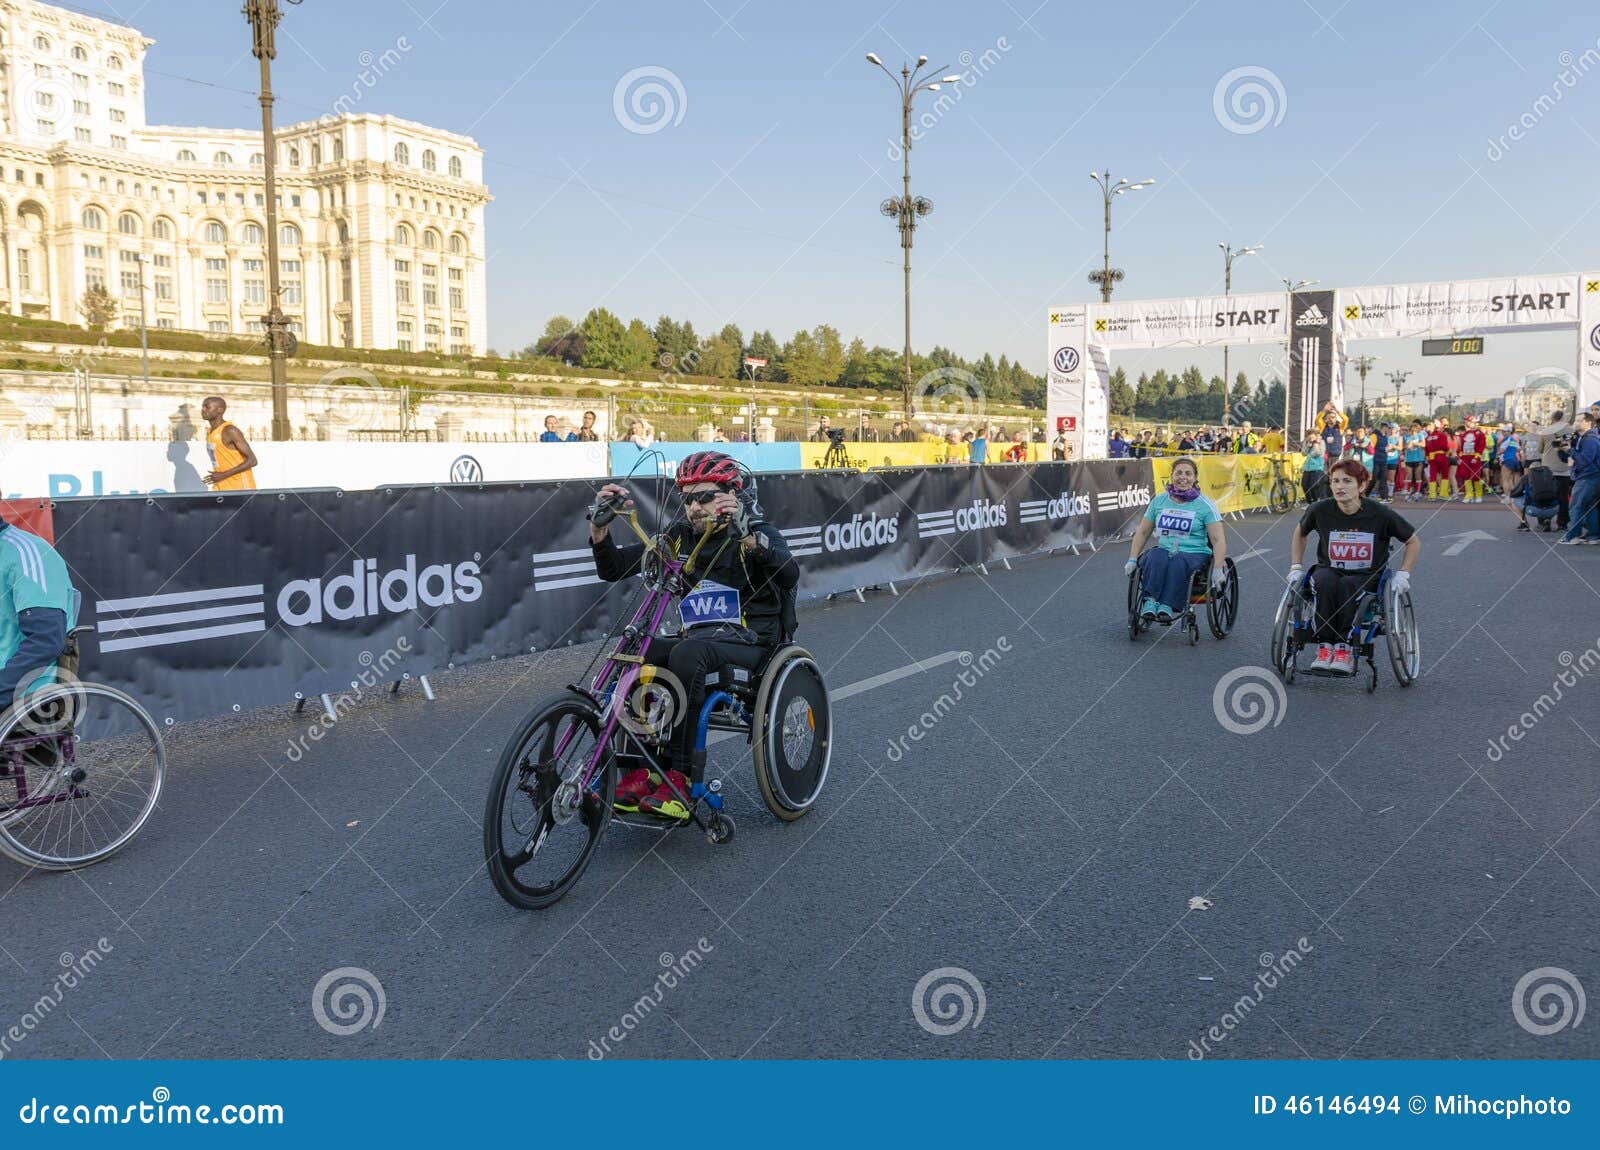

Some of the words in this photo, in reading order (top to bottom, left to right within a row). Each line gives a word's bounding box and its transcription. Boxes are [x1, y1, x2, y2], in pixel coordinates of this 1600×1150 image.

[1407, 300, 1445, 308] Bucharest
[1467, 305, 1489, 314] 2014
[1491, 292, 1570, 312] START
[1108, 317, 1141, 325] Raiffeisen
[1215, 309, 1280, 327] START
[1295, 317, 1328, 326] adidas
[1048, 491, 1091, 518] adidas
[1118, 484, 1150, 509] adidas
[956, 500, 1007, 531] adidas
[1161, 516, 1189, 530] W10
[824, 512, 899, 552] adidas
[1332, 545, 1369, 558] W16
[276, 552, 483, 627] adidas
[689, 596, 728, 616] W4
